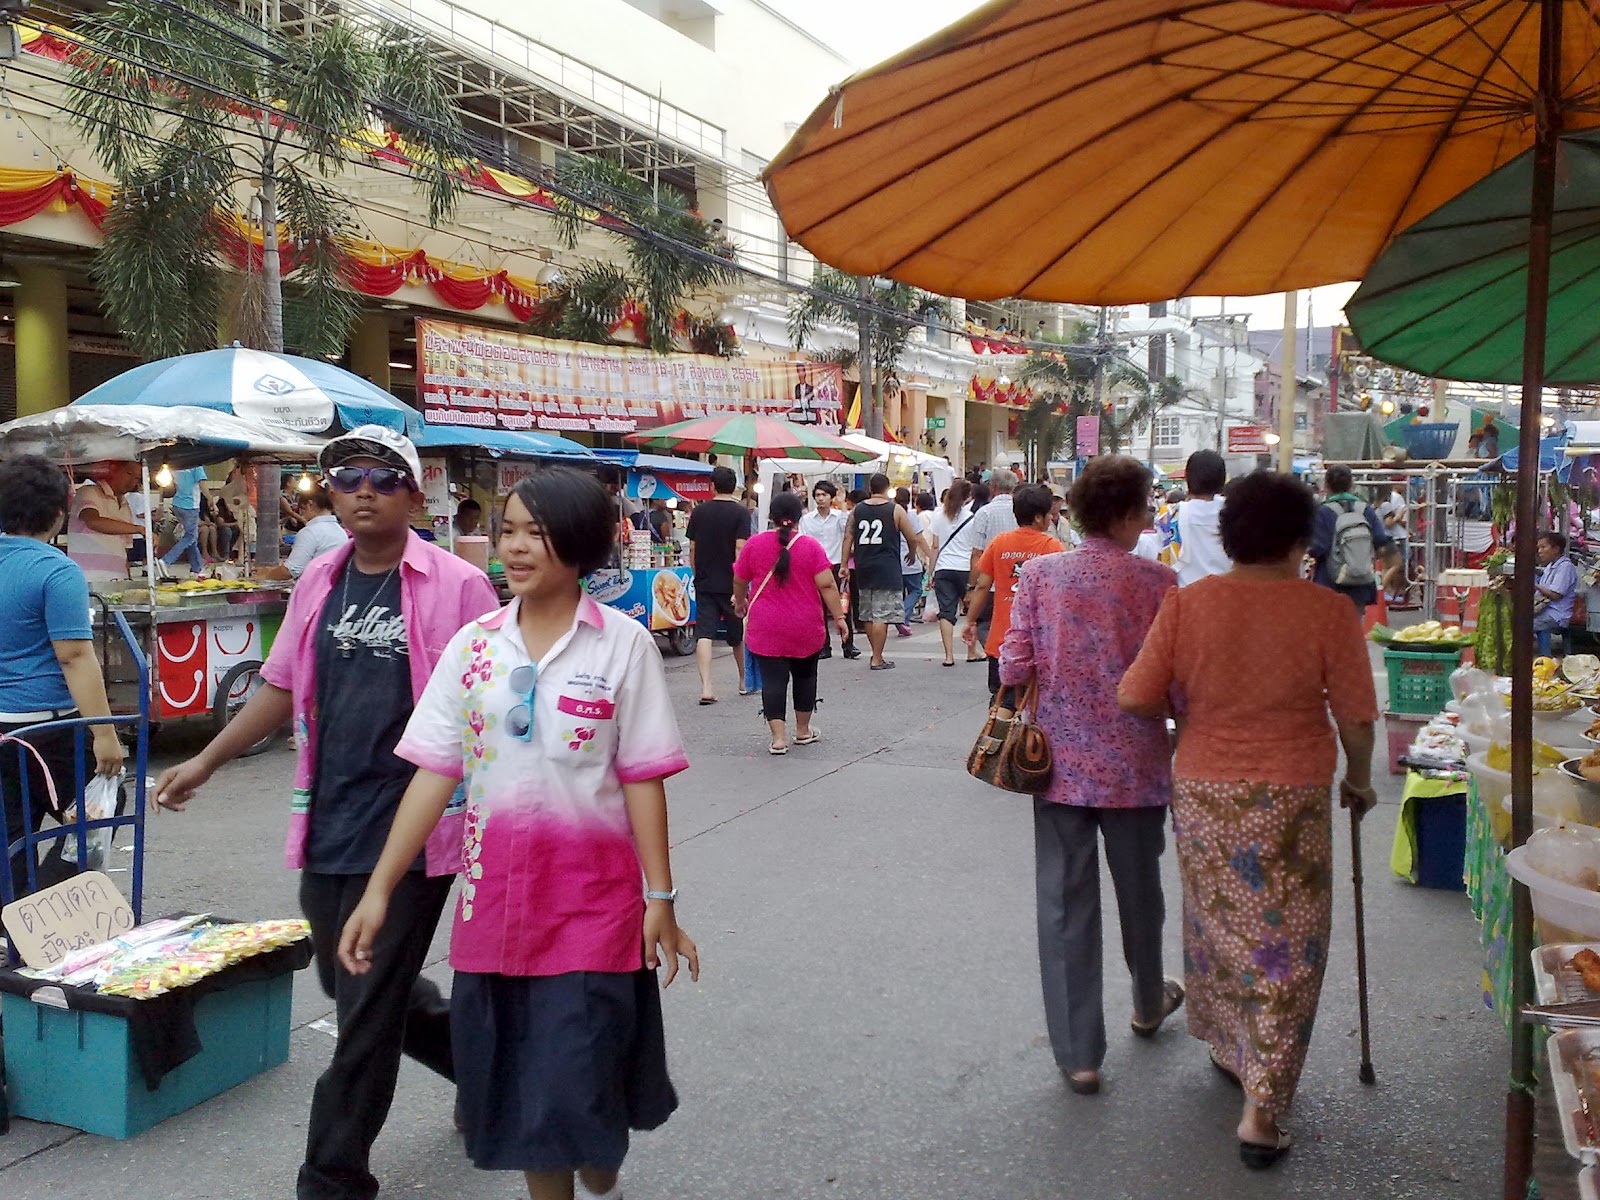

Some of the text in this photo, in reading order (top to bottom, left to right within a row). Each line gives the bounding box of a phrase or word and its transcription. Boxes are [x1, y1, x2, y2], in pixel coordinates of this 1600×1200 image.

[731, 366, 760, 383] 2554
[858, 519, 883, 545] 22
[96, 906, 132, 940] 20
